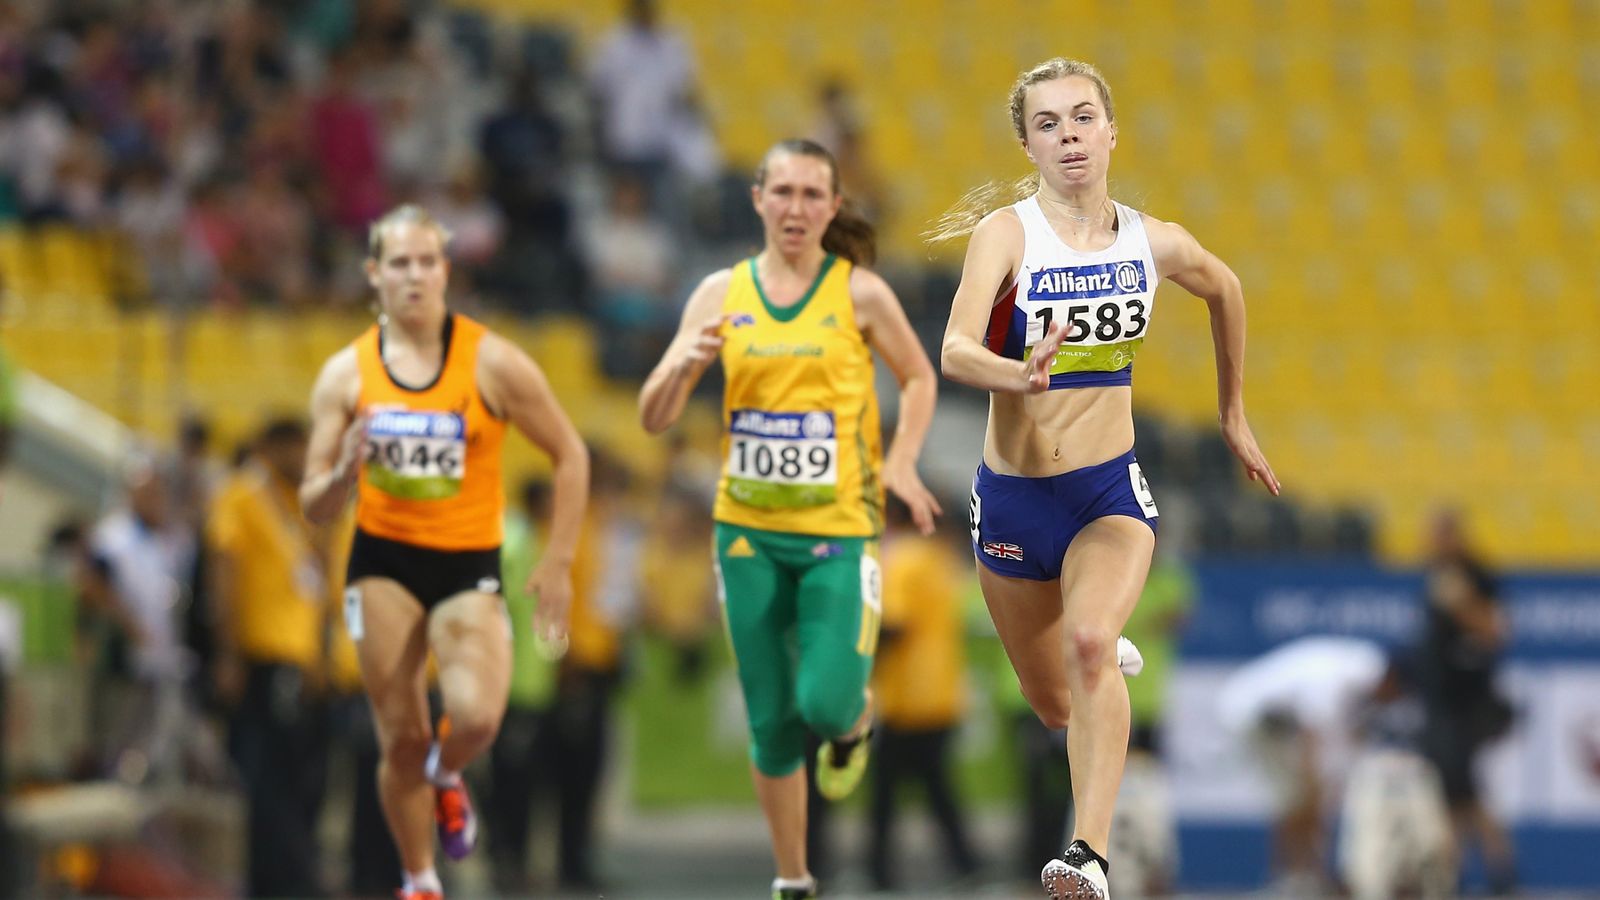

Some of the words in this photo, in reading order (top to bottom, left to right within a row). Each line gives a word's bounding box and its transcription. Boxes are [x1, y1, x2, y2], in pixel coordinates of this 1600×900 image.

[1036, 271, 1112, 293] Allianz
[1035, 299, 1146, 343] 1583
[744, 343, 823, 357] Australia
[734, 410, 800, 437] Allianz
[736, 441, 831, 478] 1089
